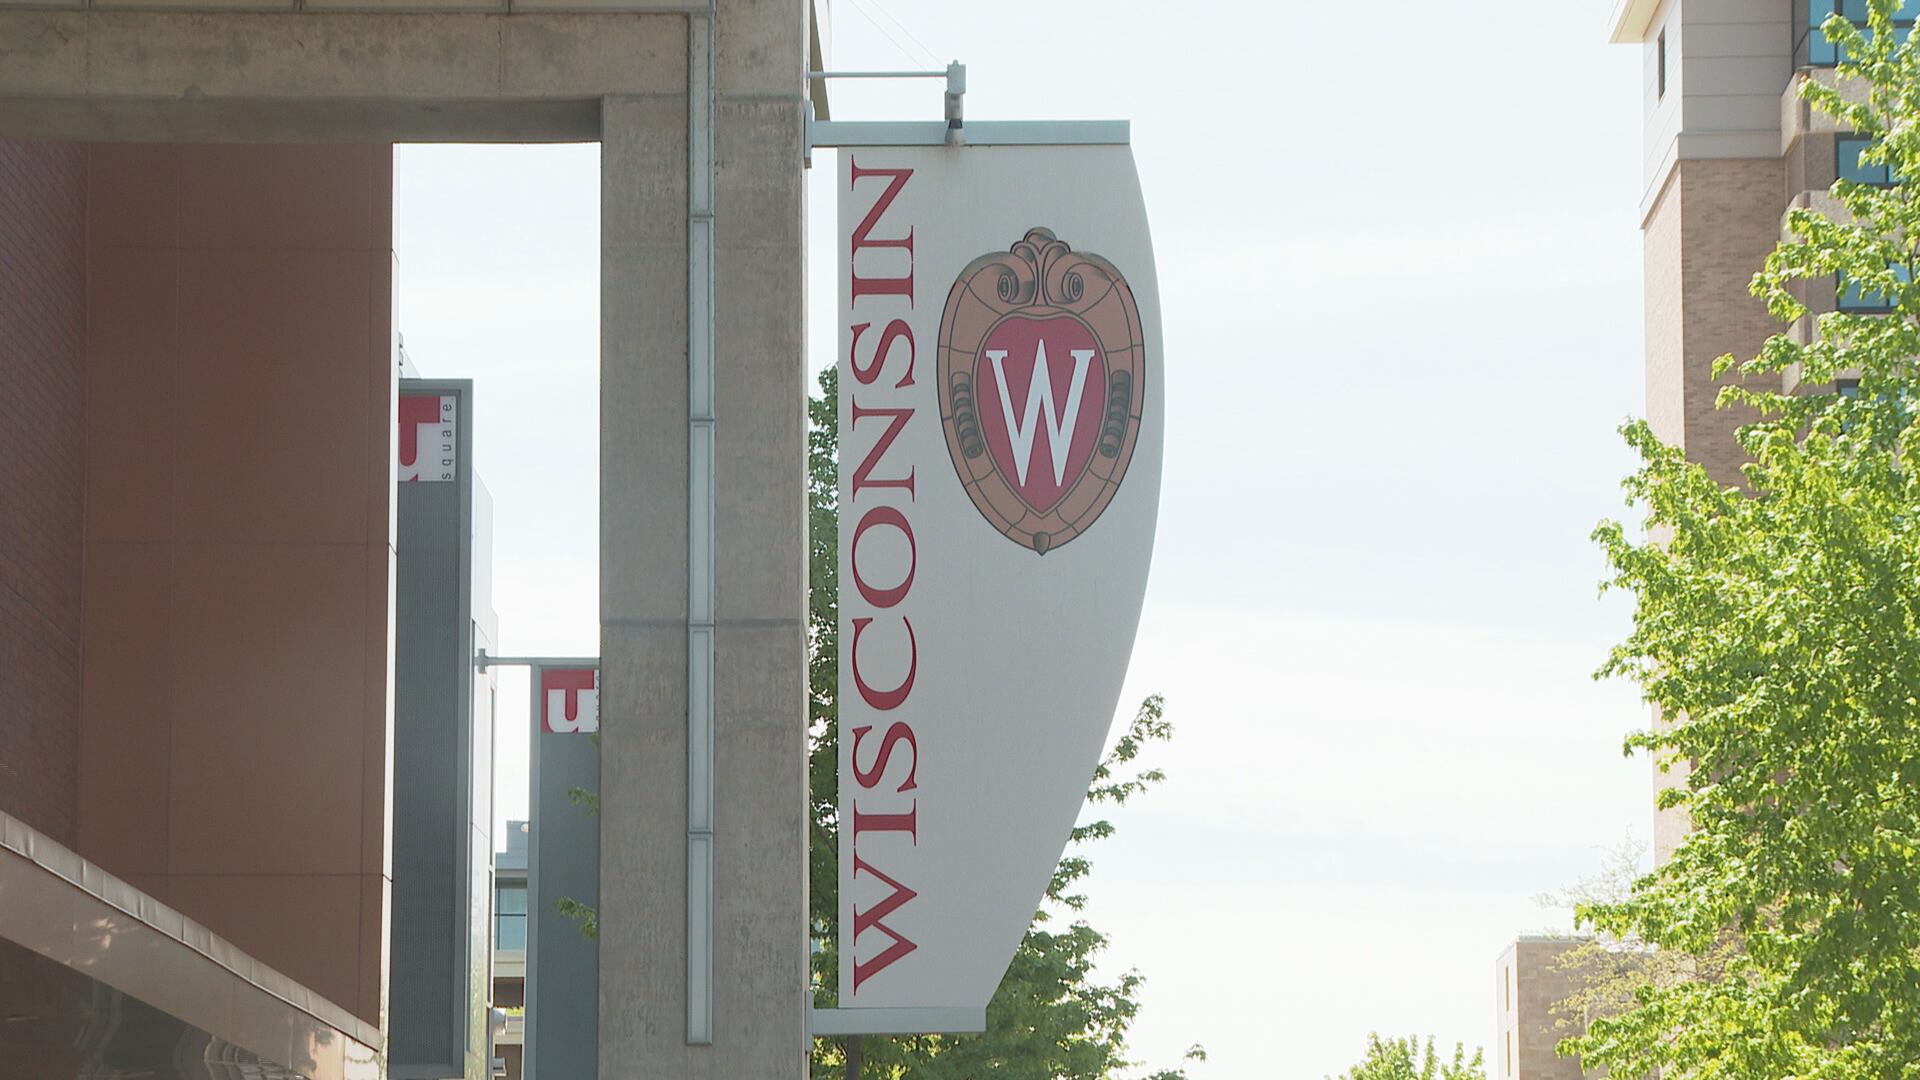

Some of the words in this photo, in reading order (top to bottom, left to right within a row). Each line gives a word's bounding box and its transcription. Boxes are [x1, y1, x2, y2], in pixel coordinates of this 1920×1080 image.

[441, 403, 454, 480] square
[985, 338, 1095, 488] W
[851, 154, 917, 997] WISCONSIN
